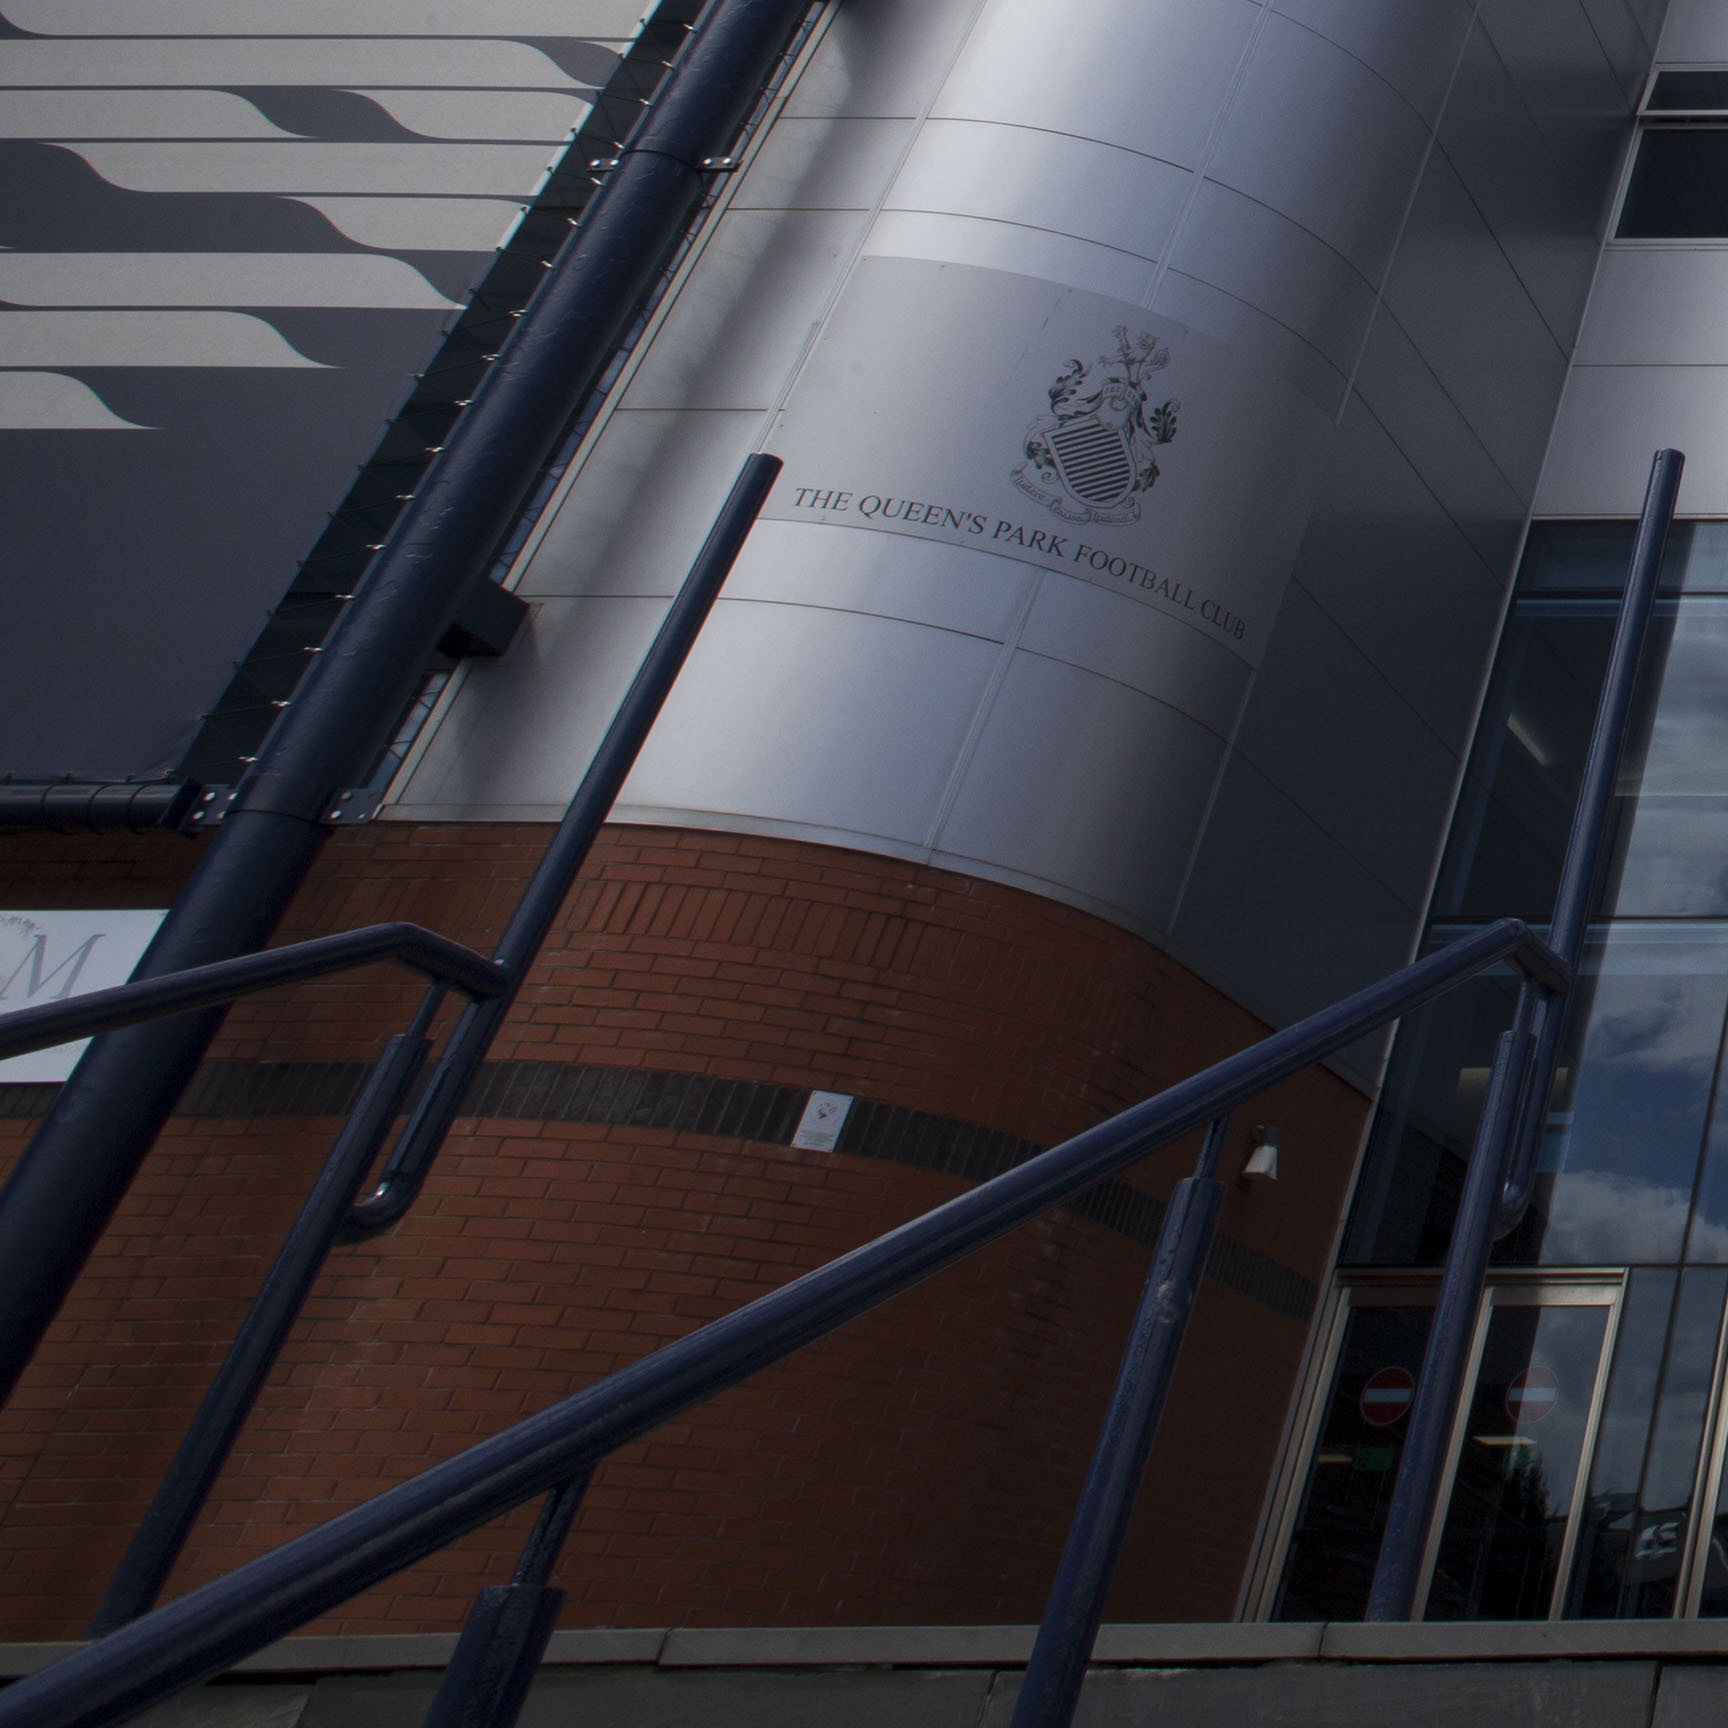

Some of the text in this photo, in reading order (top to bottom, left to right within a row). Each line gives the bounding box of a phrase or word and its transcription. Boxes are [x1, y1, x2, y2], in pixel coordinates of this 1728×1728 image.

[794, 486, 1247, 641] THE QUEEN'S PARK FOOTBALL CLUB
